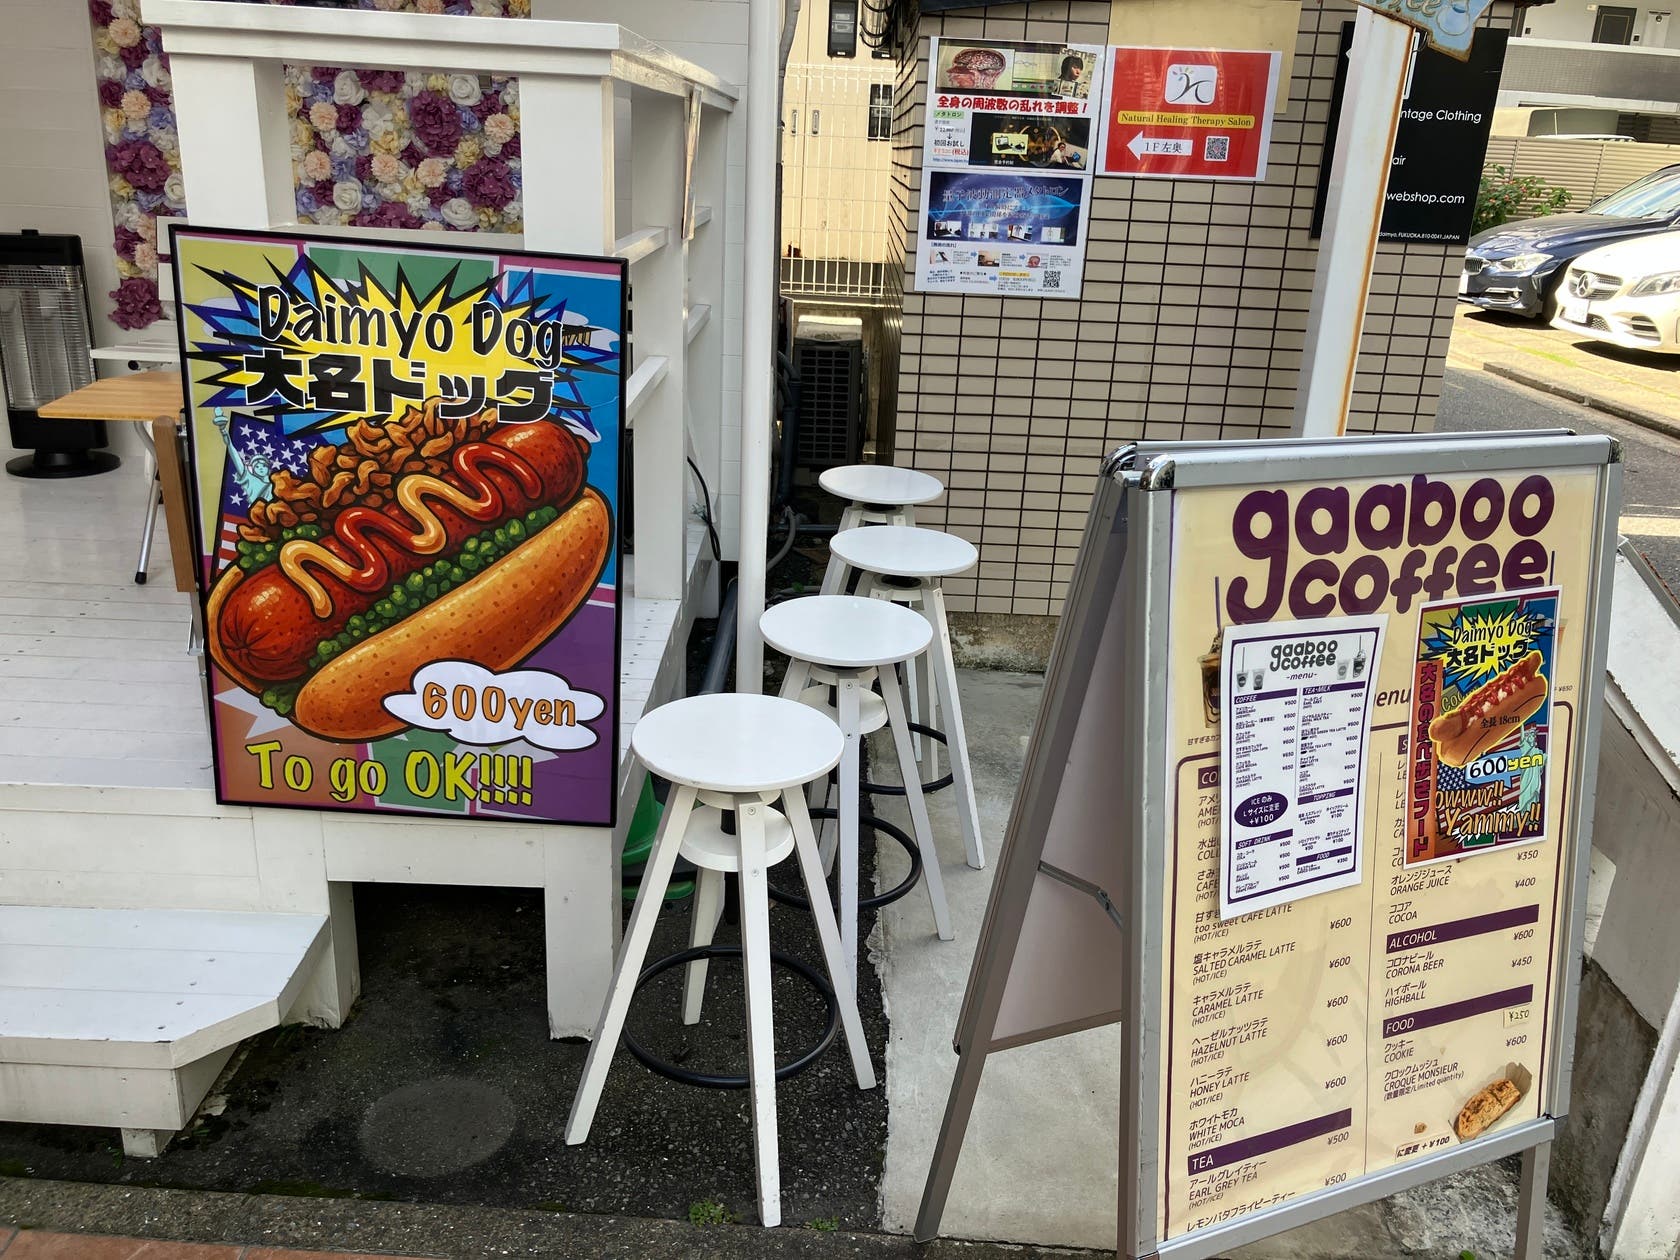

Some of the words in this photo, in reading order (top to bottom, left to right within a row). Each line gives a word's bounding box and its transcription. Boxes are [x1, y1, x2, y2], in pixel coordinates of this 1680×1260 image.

[1121, 113, 1154, 123] Natural
[1156, 115, 1188, 125] Healing
[1191, 116, 1226, 126] Therapy
[1228, 117, 1251, 126] Salon
[1400, 108, 1433, 122] ntage
[1436, 110, 1482, 124] Clothing
[1392, 155, 1406, 166] air
[257, 285, 453, 355] Daimyo
[471, 301, 563, 368] Dog
[245, 349, 555, 423] 大名ドッグ
[1226, 474, 1555, 625] gaaboo
[1289, 539, 1549, 617] coffee
[1452, 624, 1504, 644] Daimyo
[1508, 618, 1532, 639] Dog
[1270, 640, 1338, 672] gaaboo
[1281, 652, 1337, 670] coffee
[1446, 638, 1529, 666] 大名ドッグ
[422, 681, 577, 731] 600yen
[1236, 694, 1257, 704] COFFEE
[1374, 688, 1412, 708] enu
[1480, 716, 1497, 728] 全長
[1499, 714, 1520, 728] 18cm
[1412, 662, 1437, 858] 大名の食べ歩きフード
[1469, 754, 1544, 780] 600yen
[247, 741, 312, 791] To
[330, 758, 387, 802] go
[404, 750, 533, 806] OK!!!!
[1445, 803, 1541, 838] Yammy!!
[1517, 850, 1538, 861] ¥350
[1391, 866, 1452, 885] オレンジジュース
[1515, 878, 1536, 888] ¥400
[1390, 882, 1424, 896] ORANGE
[1426, 876, 1450, 890] JUICE
[1390, 902, 1412, 914] ココア
[1195, 921, 1210, 934] too
[1266, 904, 1292, 918] LATTE
[1330, 917, 1352, 930] ¥600
[1388, 912, 1418, 925] COCOA
[1194, 929, 1229, 944] (HOT/ICE)
[1389, 930, 1438, 950] ALCOHOL
[1513, 929, 1534, 940] ¥600
[1193, 940, 1262, 964] 塩キャラメルラテ
[1193, 960, 1226, 976] SALTED
[1228, 950, 1267, 970] CARAMEL
[1270, 942, 1296, 957] LATTE
[1386, 951, 1434, 969] コロナビール
[1329, 956, 1351, 969] ¥600
[1386, 964, 1420, 980] CORONA
[1423, 958, 1444, 972] BEER
[1512, 956, 1532, 968] ¥450
[1192, 970, 1228, 986] (HOT/ICE)
[1193, 982, 1252, 1006] キャラメルラテ
[1385, 980, 1426, 998] ハイボール
[1192, 997, 1233, 1017] CARAMEL
[1236, 990, 1264, 1006] LATTE
[1326, 995, 1348, 1008] ¥600
[1384, 991, 1426, 1008] HIGHBALL
[1192, 1011, 1226, 1027] (HOT/ICE)
[1508, 1009, 1530, 1022] ¥250
[1192, 1017, 1269, 1045] ヘーゼルナッツラテ
[1386, 1018, 1414, 1034] FOOD
[1191, 1036, 1237, 1058] HAZELNUT
[1239, 1028, 1268, 1044] LATTE
[1326, 1034, 1348, 1047] ¥600
[1384, 1039, 1414, 1054] クッキー
[1506, 1034, 1527, 1047] ¥600
[1190, 1051, 1224, 1068] (HOT/ICE)
[1384, 1048, 1414, 1064] COOKIE
[1190, 1066, 1232, 1087] ハニーラテ
[1384, 1058, 1438, 1080] クロックムッシュ
[1384, 1076, 1416, 1092] CROQUE
[1418, 1062, 1458, 1084] MONSIEUR
[1190, 1081, 1220, 1098] HONEY
[1222, 1072, 1250, 1088] LATTE
[1325, 1076, 1346, 1090] ¥600
[1436, 1071, 1464, 1088] quantity)
[1190, 1093, 1222, 1110] (HOT/ICE)
[1190, 1108, 1238, 1130] ホワイトモカ
[1189, 1124, 1218, 1141] WHITE
[1220, 1117, 1245, 1132] MOCA
[1188, 1134, 1222, 1151] (HOT/ICE)
[1328, 1132, 1349, 1146] ¥500
[1192, 1154, 1214, 1170] TEA
[1190, 1160, 1268, 1188] アールグレイティー
[1325, 1173, 1346, 1187] ¥500
[1190, 1186, 1212, 1200] EARL
[1216, 1178, 1238, 1193] GREY
[1242, 1172, 1258, 1185] TEA
[1188, 1192, 1224, 1210] (HOT/ICE)
